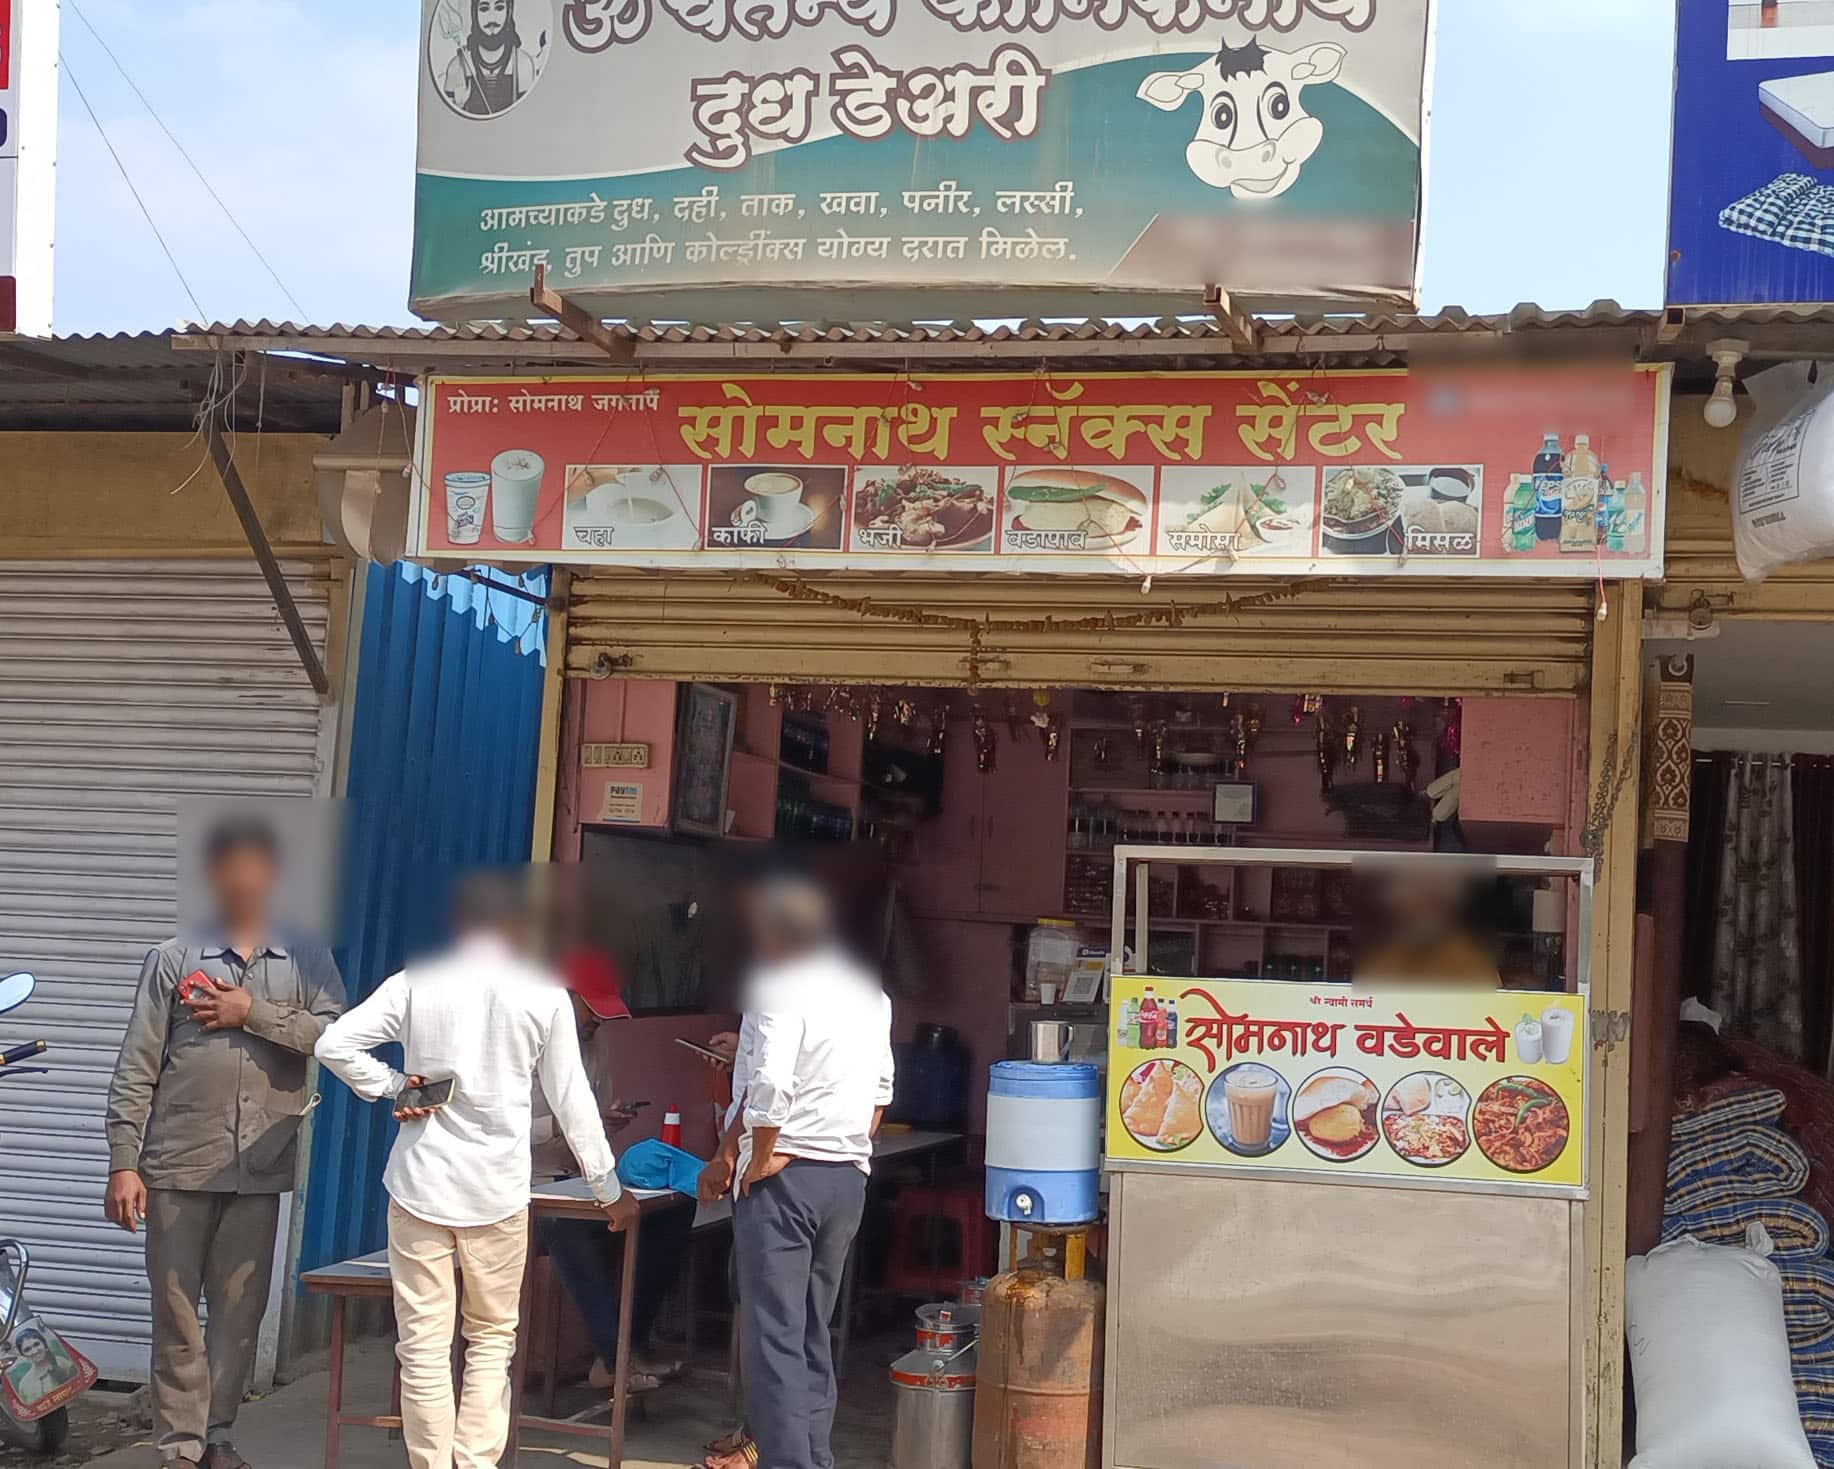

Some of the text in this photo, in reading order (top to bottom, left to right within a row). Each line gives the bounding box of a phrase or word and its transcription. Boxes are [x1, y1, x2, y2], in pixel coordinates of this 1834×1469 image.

[685, 44, 1052, 172] दुध डेअरी
[480, 180, 1084, 231] आमच्याकडे दुध, दही, ताक, खवा, पनीर, लस्सी,
[564, 246, 602, 278] तुप
[611, 233, 675, 267] आणि
[817, 228, 891, 260] योग्य
[901, 236, 968, 262] दरात
[979, 227, 1077, 261] मिळेल.
[508, 389, 583, 413] सोमनाथ
[678, 381, 1405, 461] सोमनाथ स्नॅक्स सेंटर
[574, 527, 614, 547] चहा
[859, 524, 902, 548] भजी
[1005, 530, 1087, 549] वडापाव
[1167, 523, 1241, 551] समोसा
[1405, 525, 1474, 552] मिसळ
[1181, 988, 1511, 1074] सोमनाथ वडेवाले
